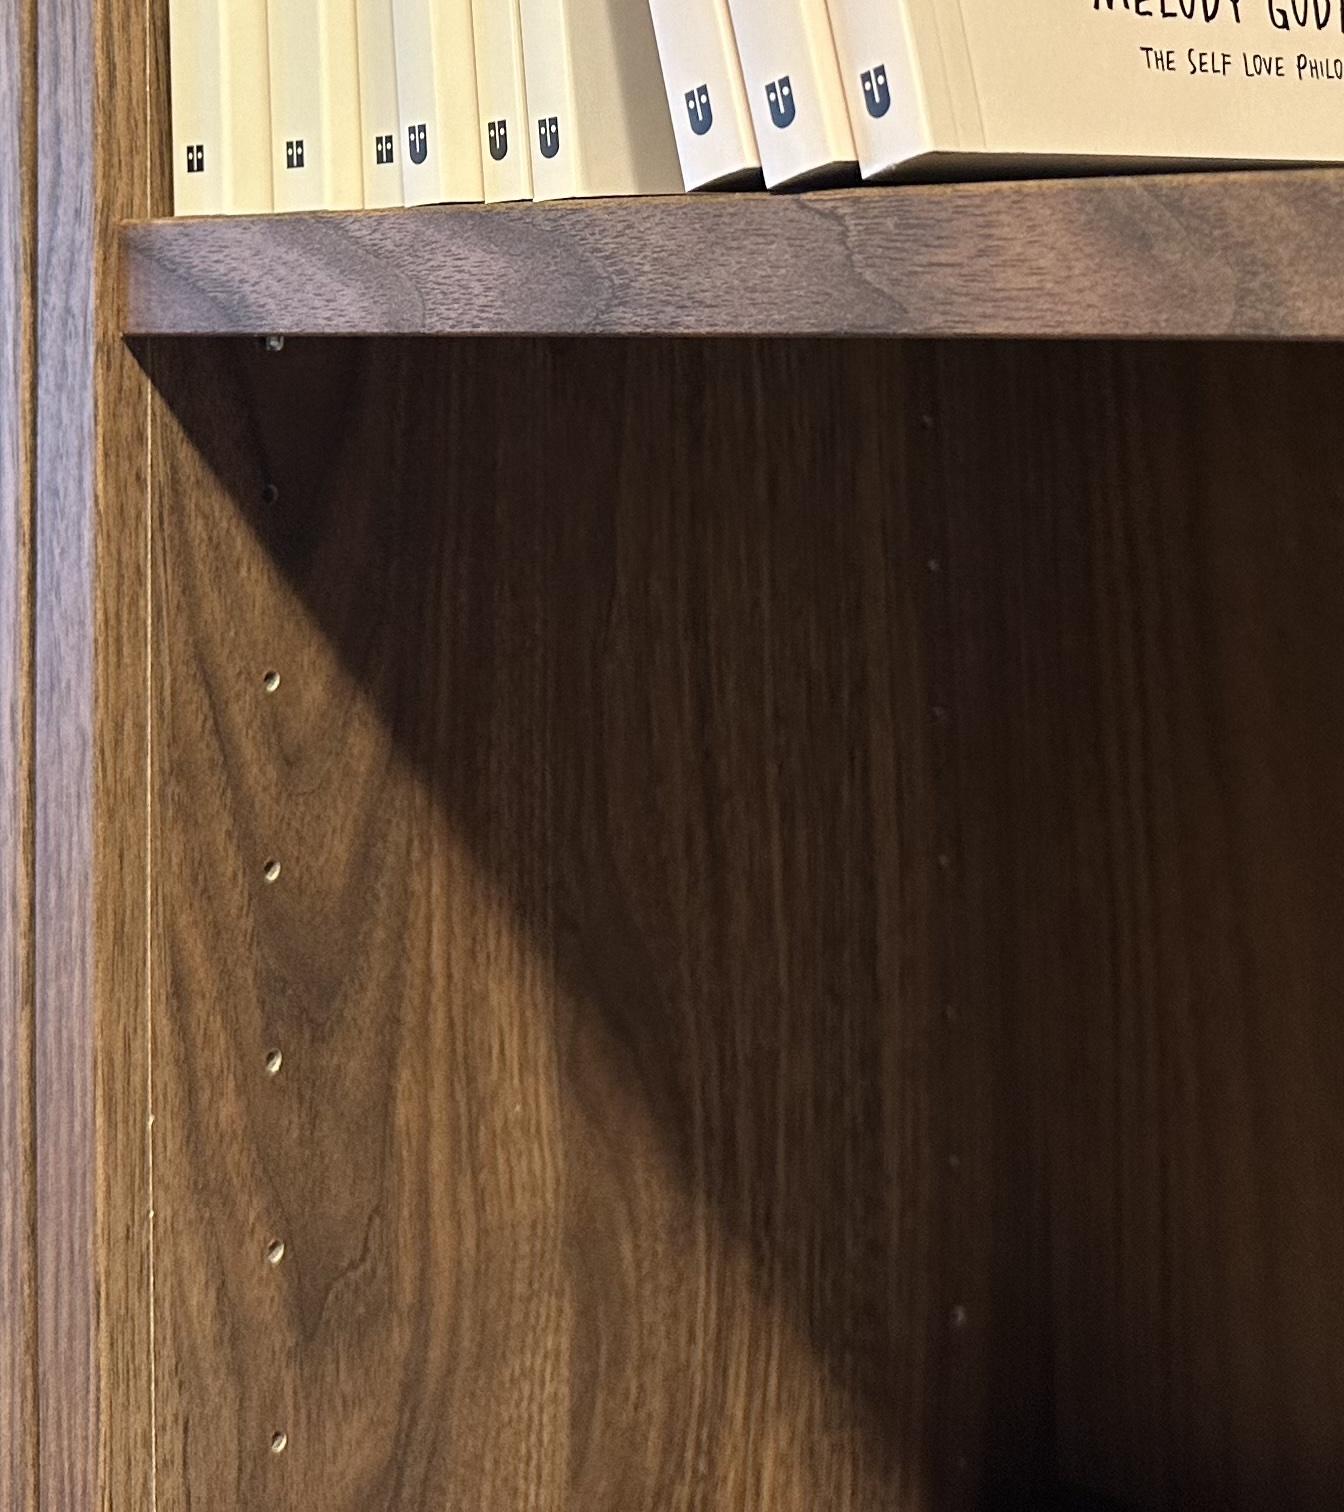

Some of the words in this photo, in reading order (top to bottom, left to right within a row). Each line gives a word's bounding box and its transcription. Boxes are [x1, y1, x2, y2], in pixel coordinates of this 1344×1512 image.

[1140, 46, 1175, 72] THE
[1188, 48, 1232, 76] SELF
[1243, 53, 1285, 78] LOVE
